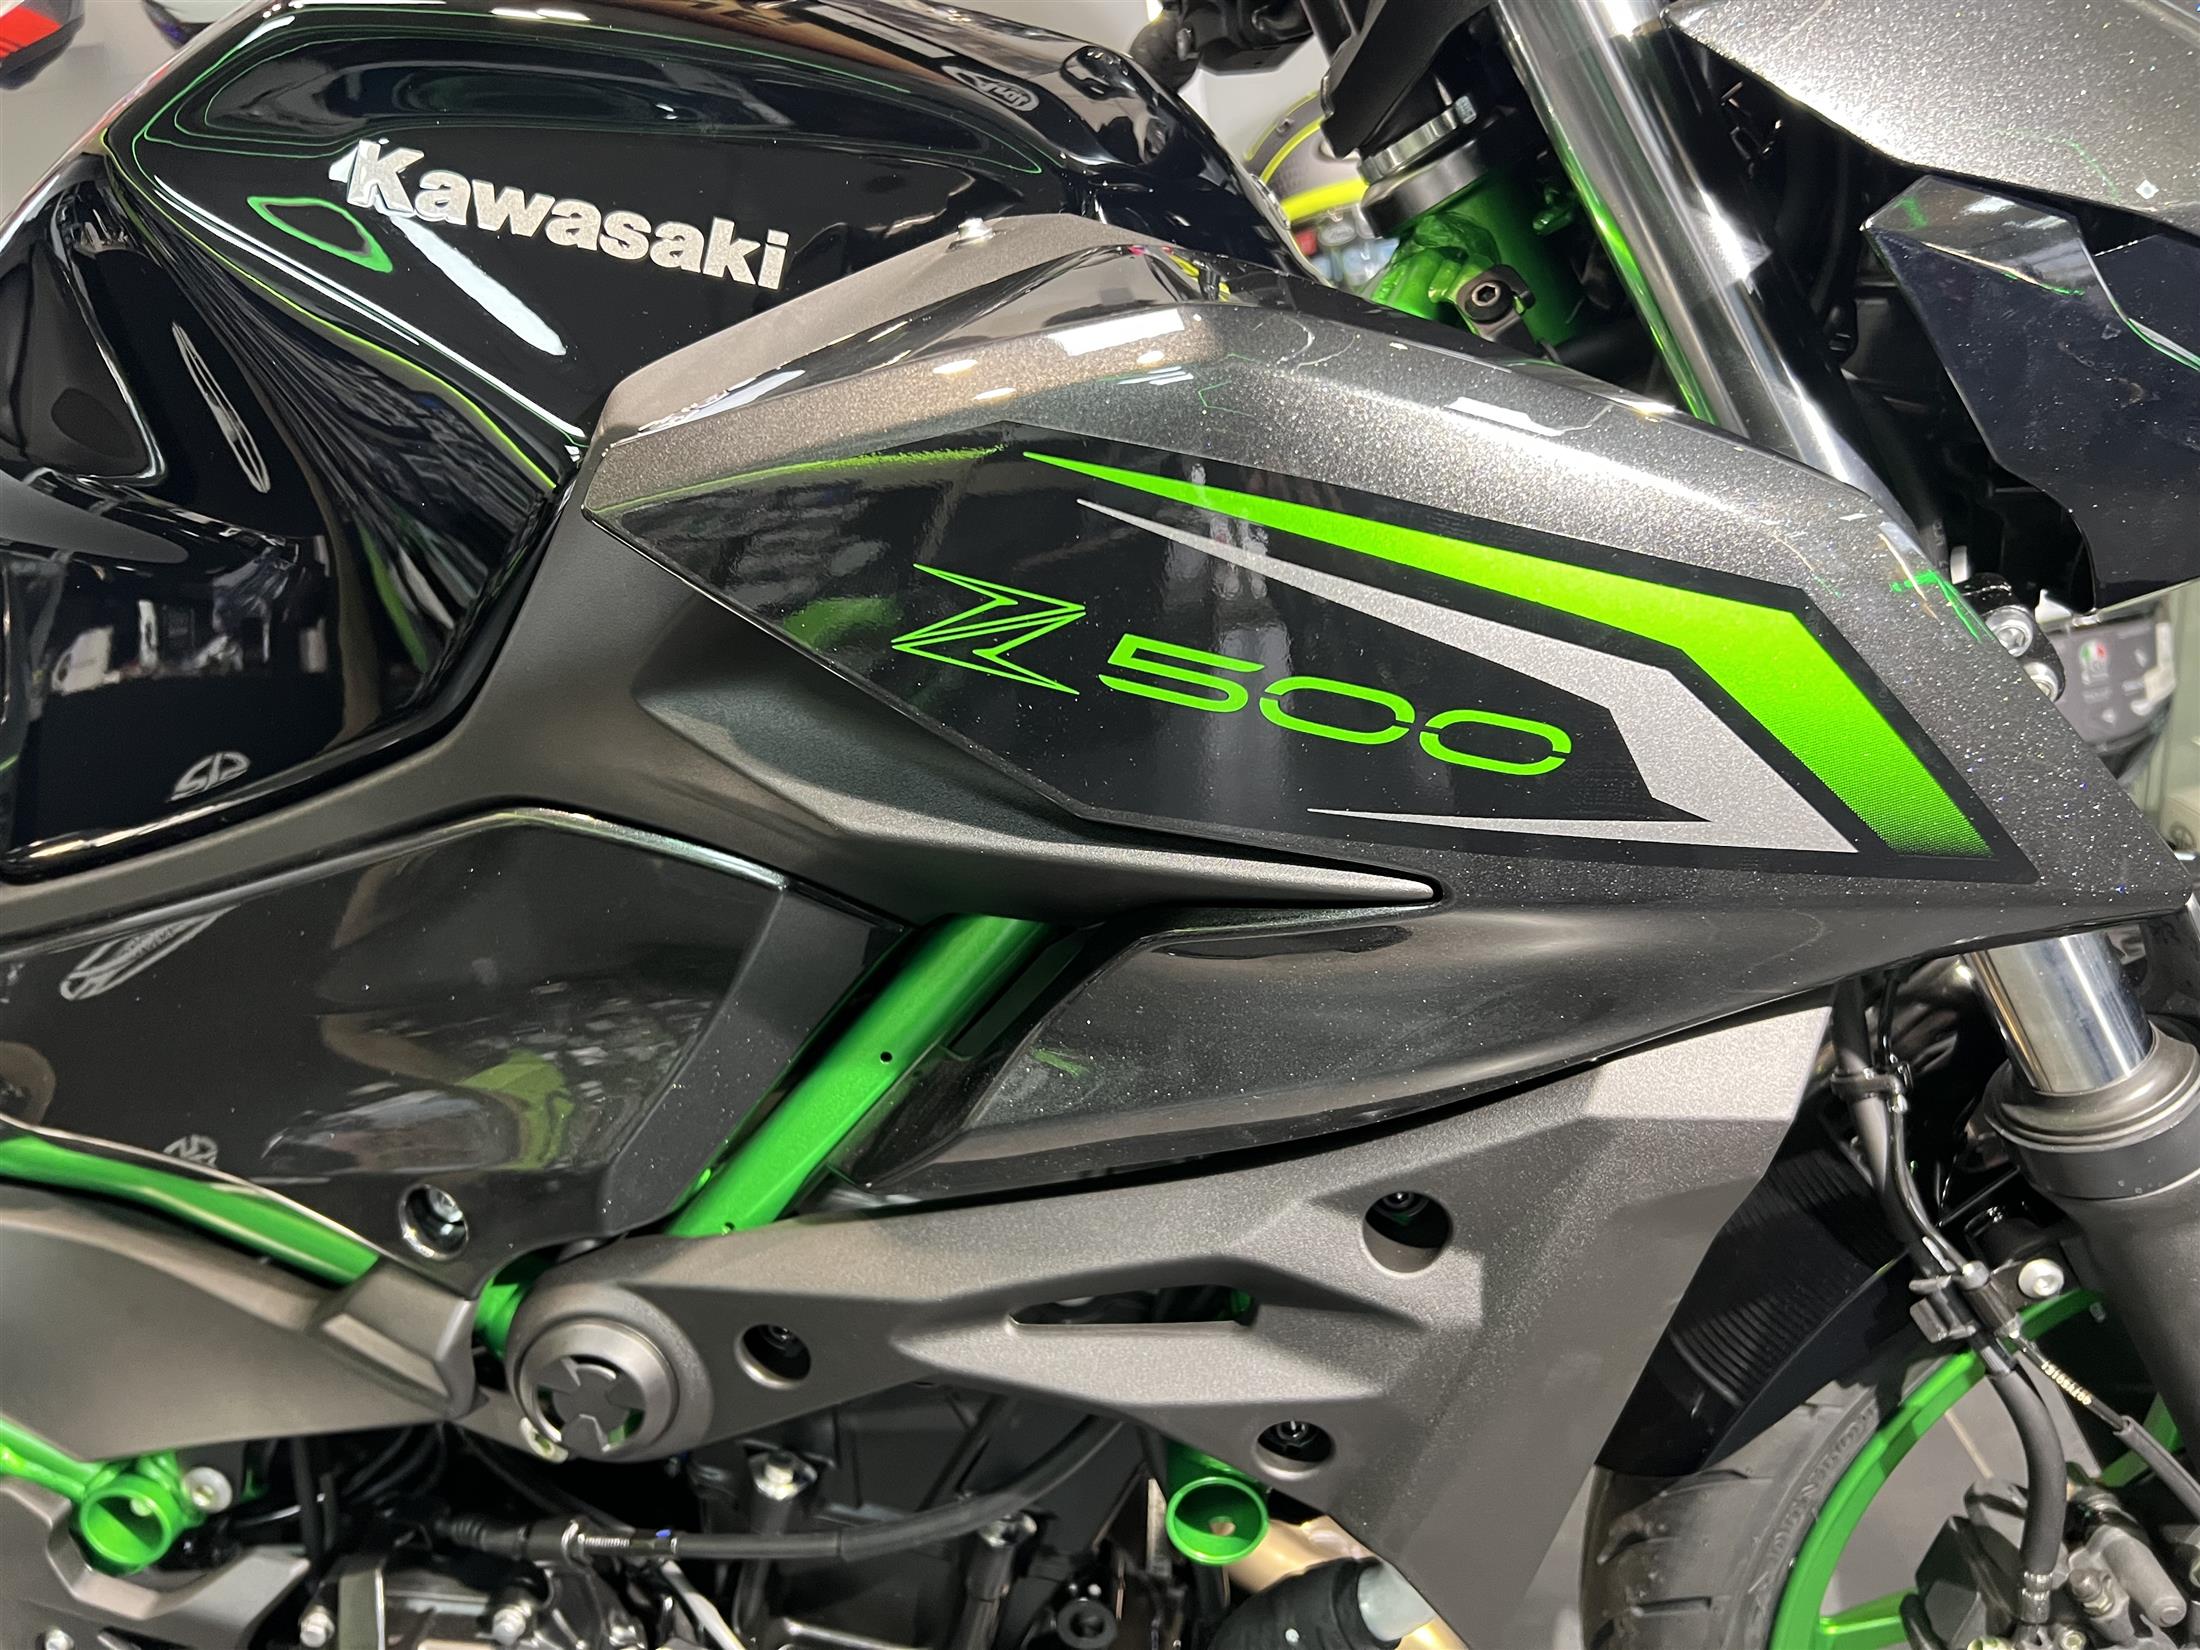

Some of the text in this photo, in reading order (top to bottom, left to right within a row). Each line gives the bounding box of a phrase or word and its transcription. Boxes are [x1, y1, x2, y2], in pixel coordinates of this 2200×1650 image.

[347, 138, 790, 290] Kawasaki
[892, 564, 1572, 777] Z 500
